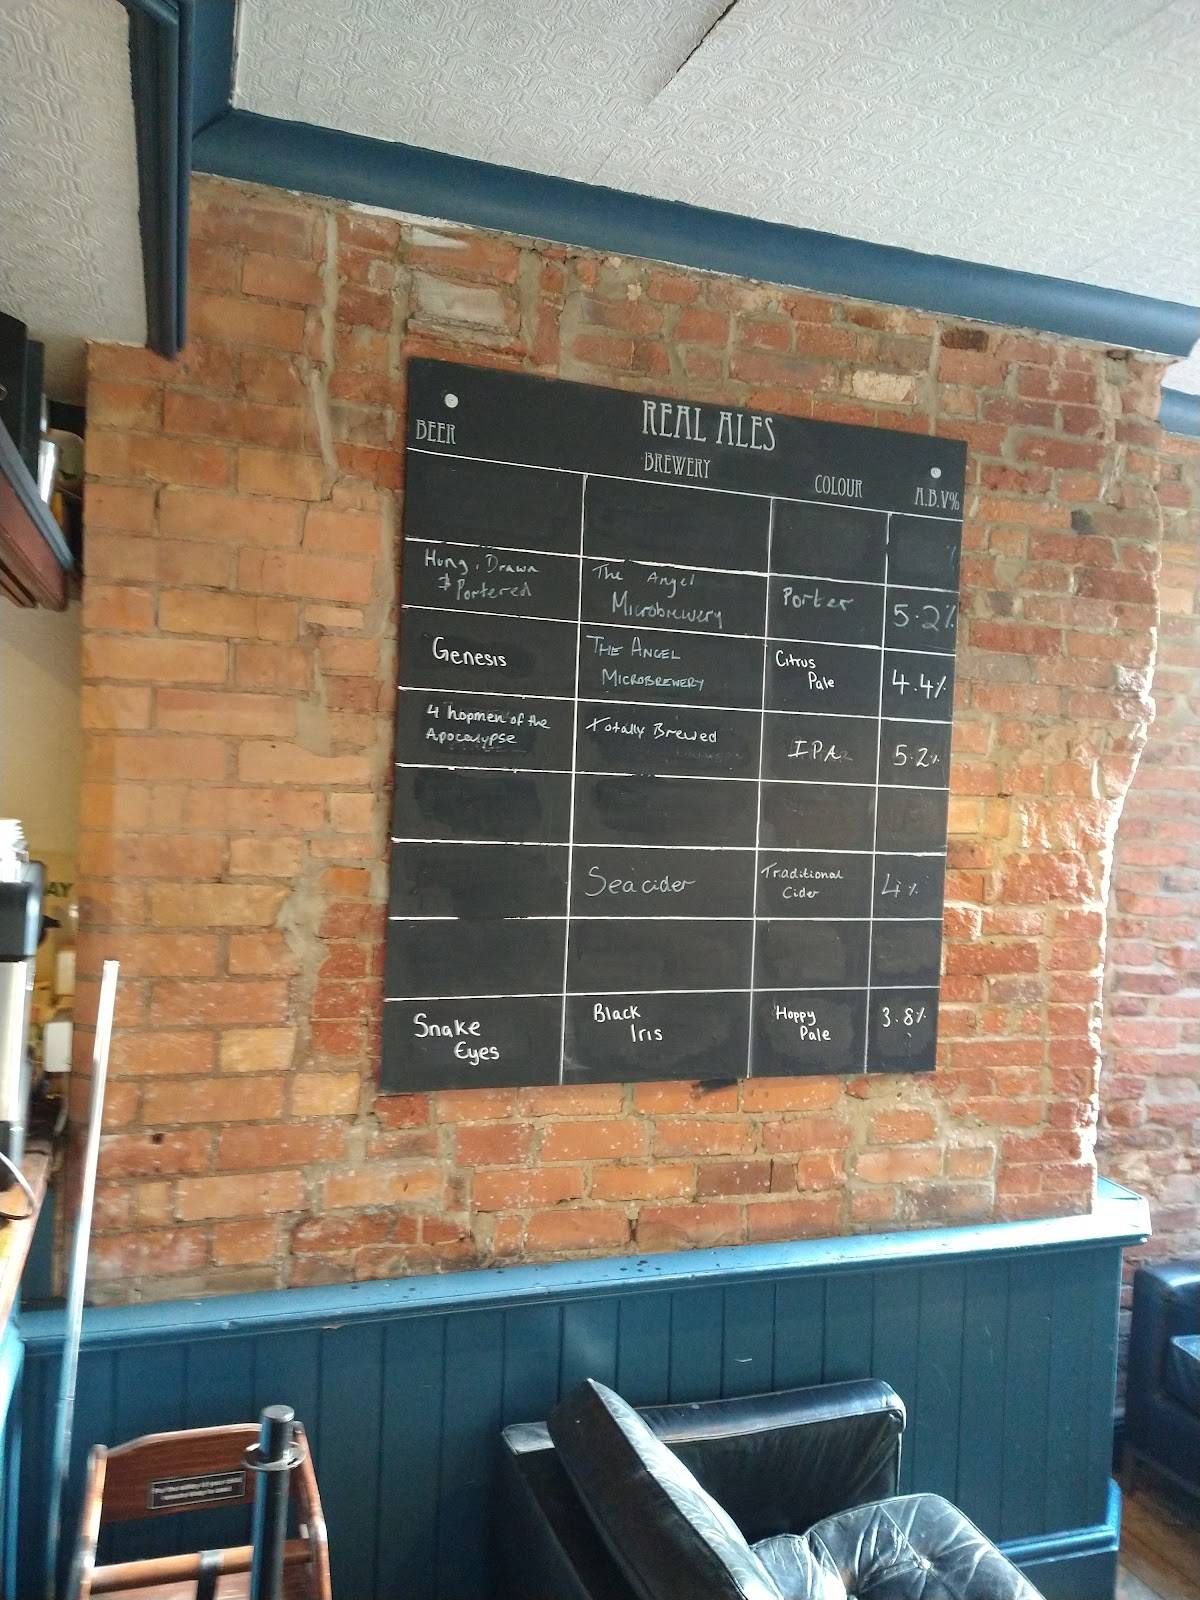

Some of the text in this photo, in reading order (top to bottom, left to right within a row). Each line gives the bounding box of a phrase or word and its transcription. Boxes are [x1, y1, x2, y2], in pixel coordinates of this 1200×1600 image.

[415, 419, 456, 444] BEER
[642, 400, 776, 451] REAL ALES
[644, 452, 711, 479] BREWERY
[815, 474, 862, 498] COLOUR
[485, 554, 539, 573] Drawn
[457, 578, 532, 600] Portered
[592, 563, 695, 598] The Angel
[612, 590, 722, 629] Microbrewery
[783, 587, 854, 611] Porter
[432, 636, 507, 667] Genesis
[775, 650, 816, 669] Citrus
[602, 668, 705, 692] MICROBREWERY
[808, 671, 835, 690] Pale
[892, 669, 947, 699] 4.4%
[426, 704, 551, 729] 4 hopmen of the
[425, 727, 517, 749] Apocalypse
[585, 716, 718, 743] Totally Brewed
[760, 862, 844, 880] Traditional
[782, 886, 820, 899] Cider
[593, 1003, 641, 1023] Black
[775, 1005, 816, 1026] Hoppy
[882, 1006, 927, 1028] 3.8%
[413, 1013, 481, 1038] Snake
[630, 1025, 663, 1043] Iris
[800, 1025, 831, 1042] Pale
[453, 1041, 500, 1066] Eyes
